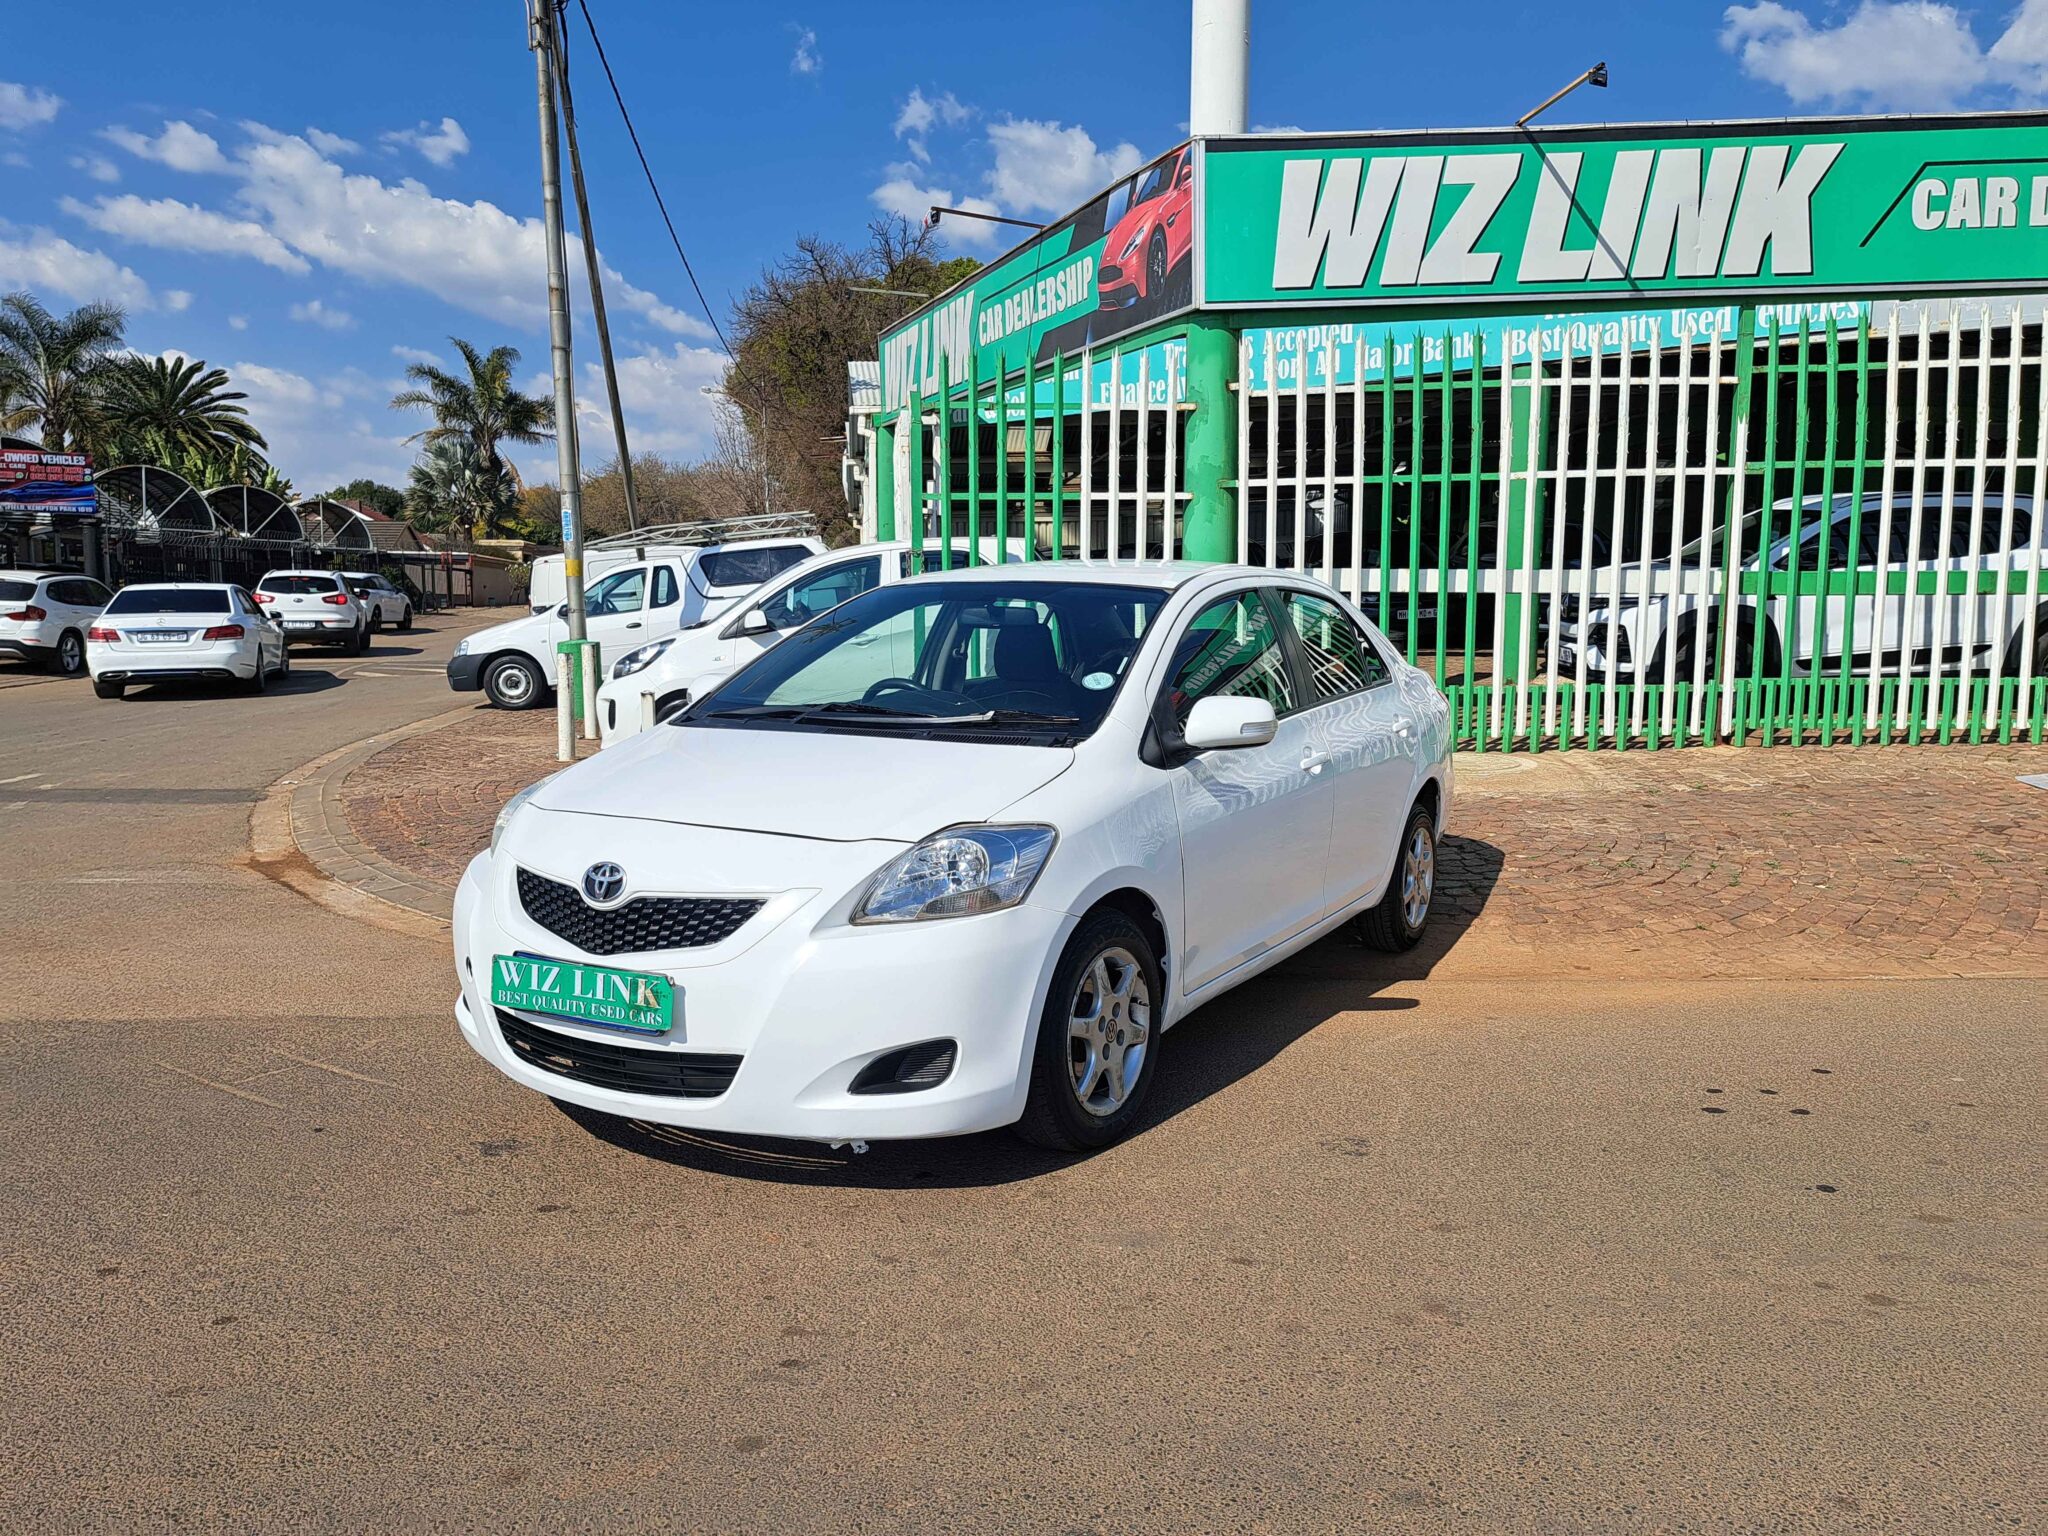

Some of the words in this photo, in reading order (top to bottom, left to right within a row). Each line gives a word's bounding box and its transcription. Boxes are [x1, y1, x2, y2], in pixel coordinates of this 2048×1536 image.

[1273, 152, 1523, 289] WIZ
[1518, 142, 1848, 283] LINK
[1911, 176, 2020, 230] CAR
[978, 303, 1004, 347] CAR
[1005, 255, 1093, 336] DEALERSHIP
[1671, 307, 1732, 338] Used
[1757, 300, 1860, 328] ehicles
[884, 323, 919, 414] WIZ
[920, 289, 975, 398] LINK
[1314, 348, 1341, 375] Al
[1355, 342, 1413, 371] aor
[1100, 380, 1166, 404] Fnace
[41, 454, 86, 466] VEHICLES
[60, 505, 76, 513] PARK
[498, 959, 561, 994] WIZ
[572, 969, 663, 1009] LINK
[498, 989, 529, 1005] BEST
[532, 995, 588, 1014] QUALITY
[591, 1003, 626, 1020] USED
[629, 1008, 664, 1027] CARS
